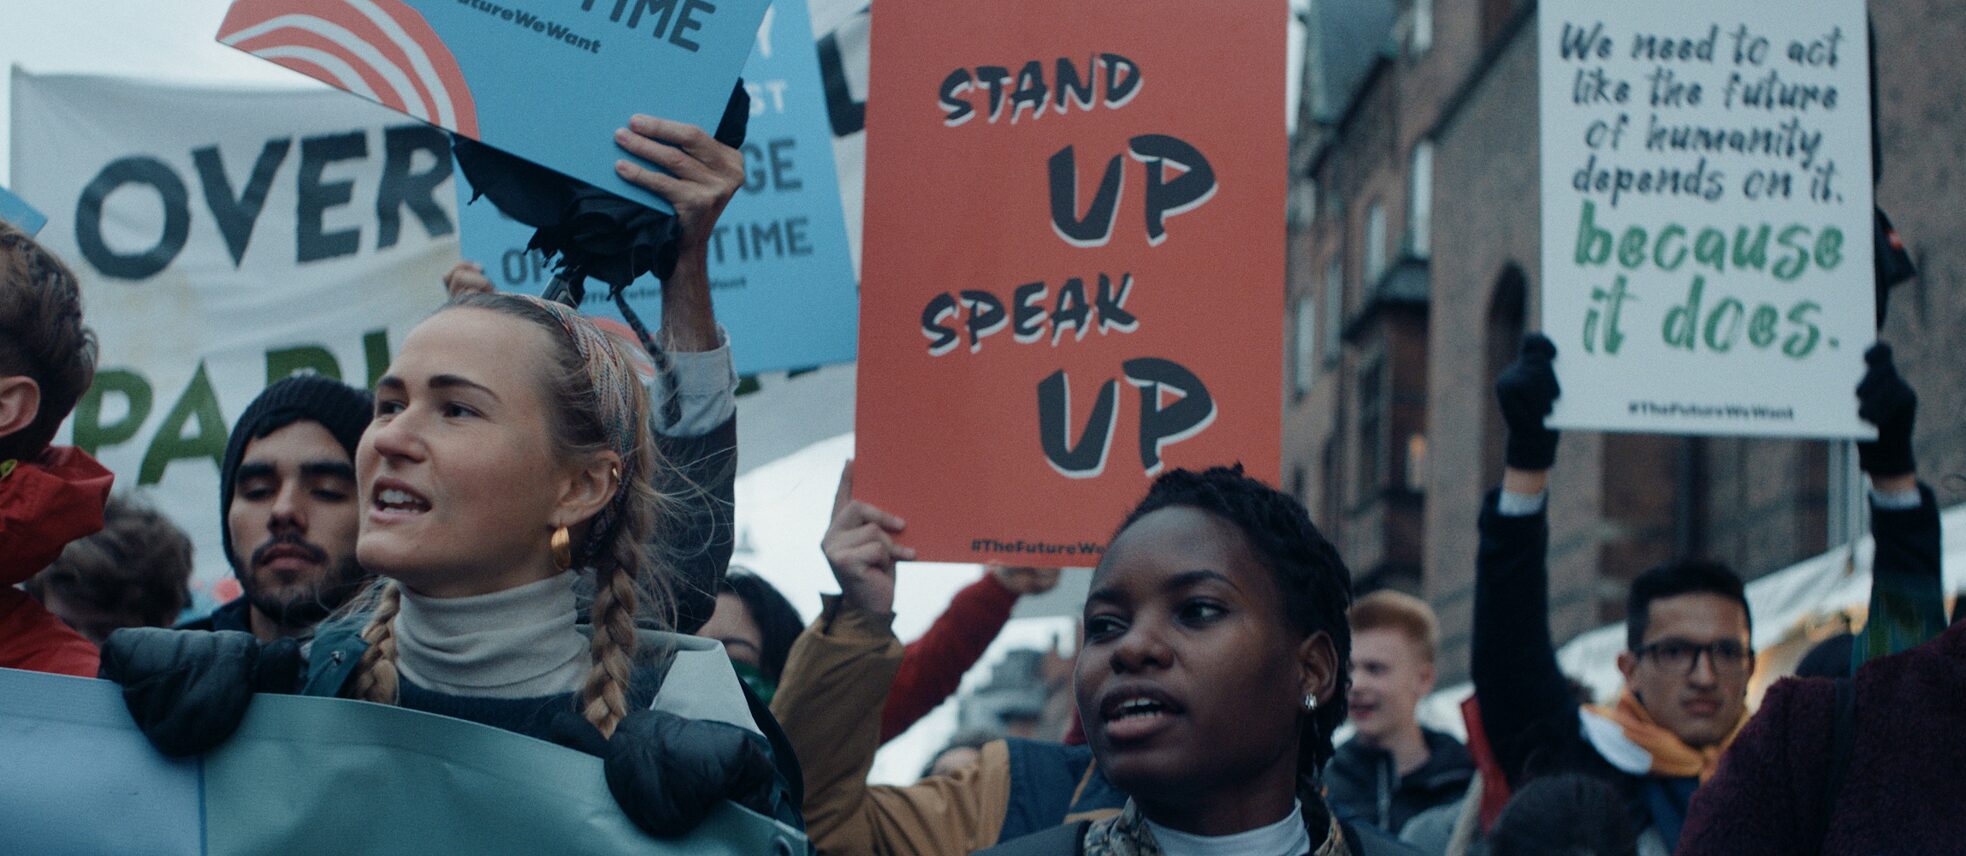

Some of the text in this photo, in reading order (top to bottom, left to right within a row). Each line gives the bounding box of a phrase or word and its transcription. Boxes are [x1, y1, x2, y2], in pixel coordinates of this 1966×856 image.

[581, 0, 717, 53] IME
[1559, 21, 1844, 68] We need to act
[938, 52, 1143, 127] STAND
[1573, 66, 1839, 111] like the future
[1585, 112, 1821, 171] of humanity
[75, 124, 456, 281] OVER
[1047, 133, 1218, 248] UP
[1572, 153, 1725, 208] depends
[1743, 168, 1792, 200] on
[1573, 199, 1844, 281] because
[920, 272, 1140, 356] SPEAK
[1582, 274, 1840, 359] it does.
[1037, 356, 1218, 479] UP
[971, 539, 1106, 554] #TheFutureWe
